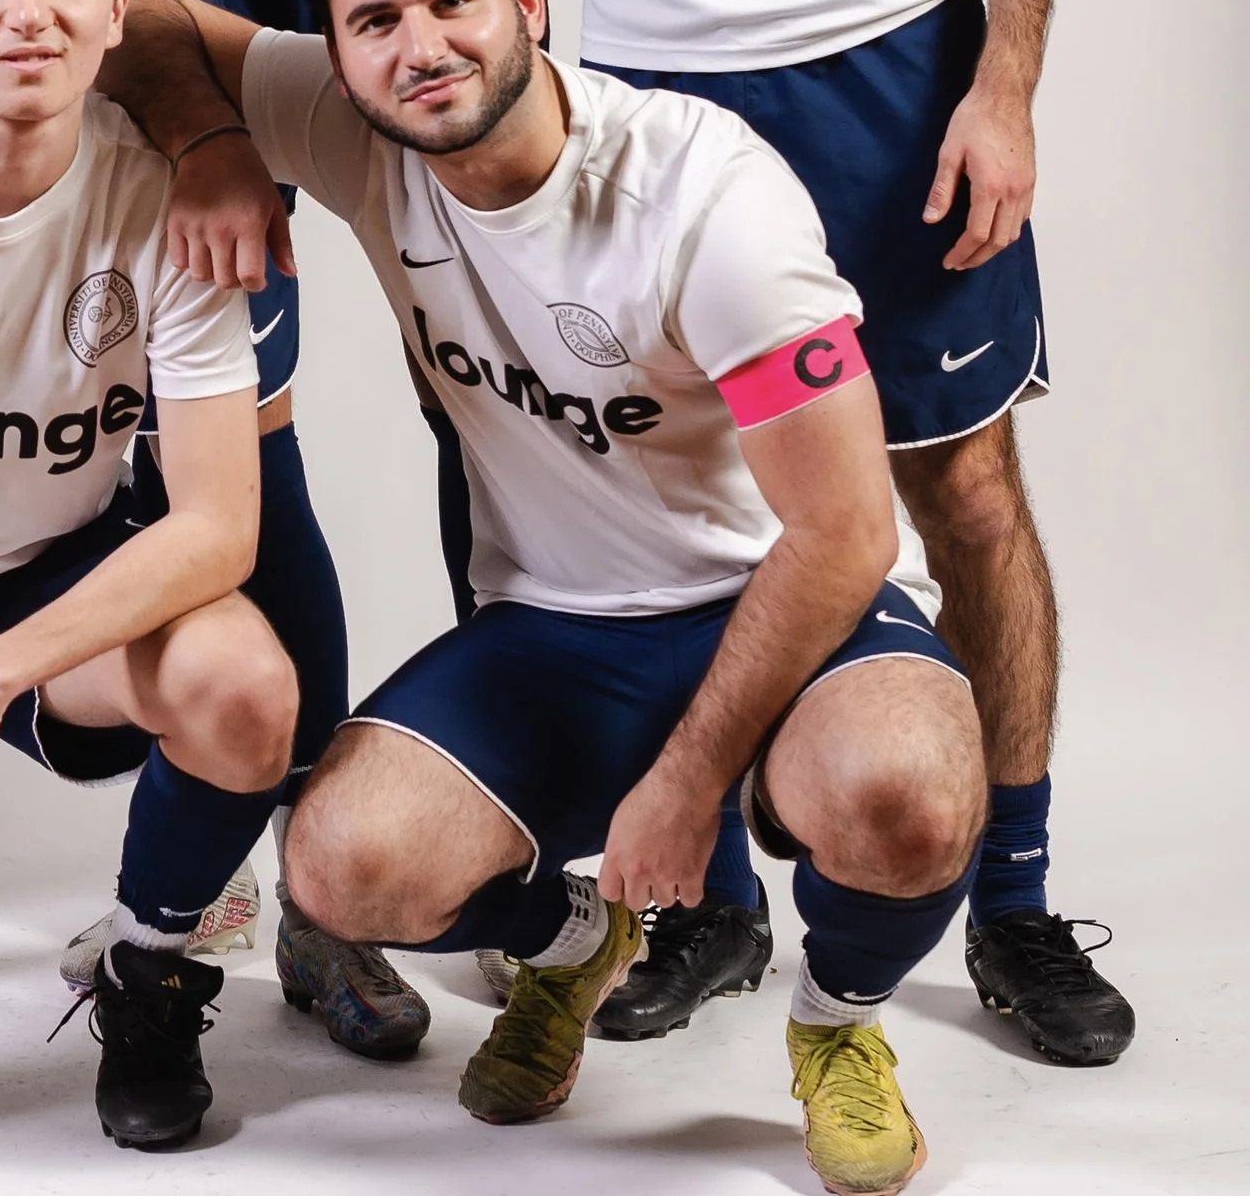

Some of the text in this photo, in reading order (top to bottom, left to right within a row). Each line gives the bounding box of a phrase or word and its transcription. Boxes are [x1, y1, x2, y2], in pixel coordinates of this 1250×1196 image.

[92, 277, 108, 289] OF
[558, 308, 575, 318] OF
[794, 338, 843, 389] C
